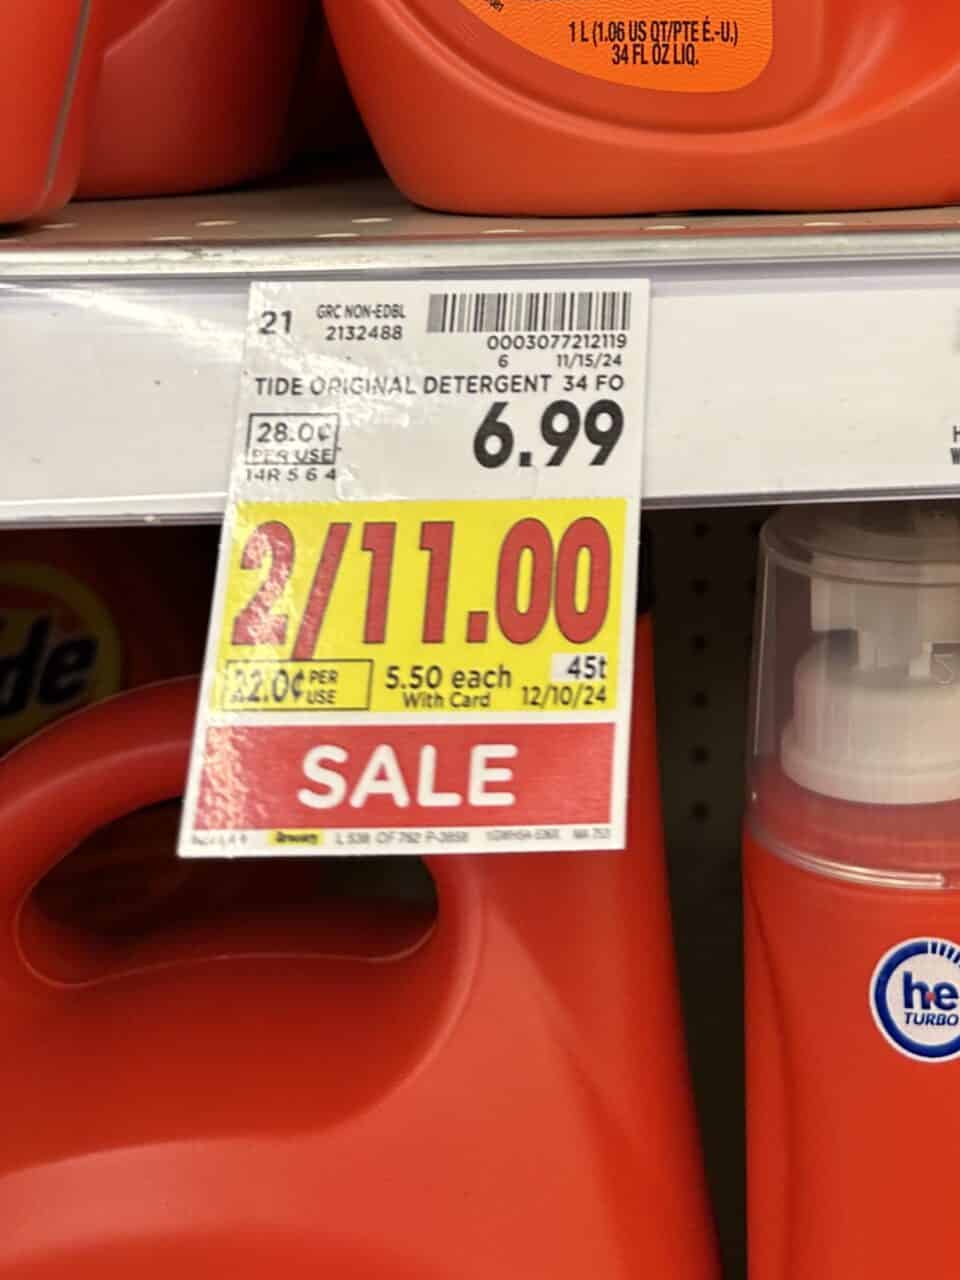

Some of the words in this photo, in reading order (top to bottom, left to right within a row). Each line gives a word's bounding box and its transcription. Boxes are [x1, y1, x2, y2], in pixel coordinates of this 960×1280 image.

[569, 21, 575, 42] 1
[581, 21, 589, 42] L
[592, 21, 625, 47] (1.06
[628, 21, 647, 42] US
[650, 20, 699, 43] QT/PTE
[612, 43, 629, 65] 34
[633, 43, 648, 64] FL
[652, 43, 669, 64] OZ
[673, 43, 699, 67] LIQ.
[258, 310, 292, 334] 21
[325, 325, 403, 341] 2132488
[487, 334, 627, 350] 0003077212119
[498, 354, 509, 368] 6
[557, 354, 622, 369] 11/15/24
[255, 377, 304, 395] TIDE
[310, 376, 416, 396] ORIGINAL
[423, 375, 552, 395] DETERGENT
[563, 375, 587, 391] 34
[595, 374, 624, 391] FO
[473, 399, 624, 469] 6.99
[230, 516, 612, 662] 2/11.00
[309, 669, 338, 684] PER
[385, 665, 442, 690] 5.50
[451, 664, 512, 689] each
[306, 689, 337, 704] USE
[402, 691, 444, 708] With
[450, 691, 491, 708] Card
[522, 685, 607, 708] 12/10/24
[298, 744, 518, 809] SALE
[903, 971, 959, 1010] he
[904, 1011, 960, 1026] TURBO
